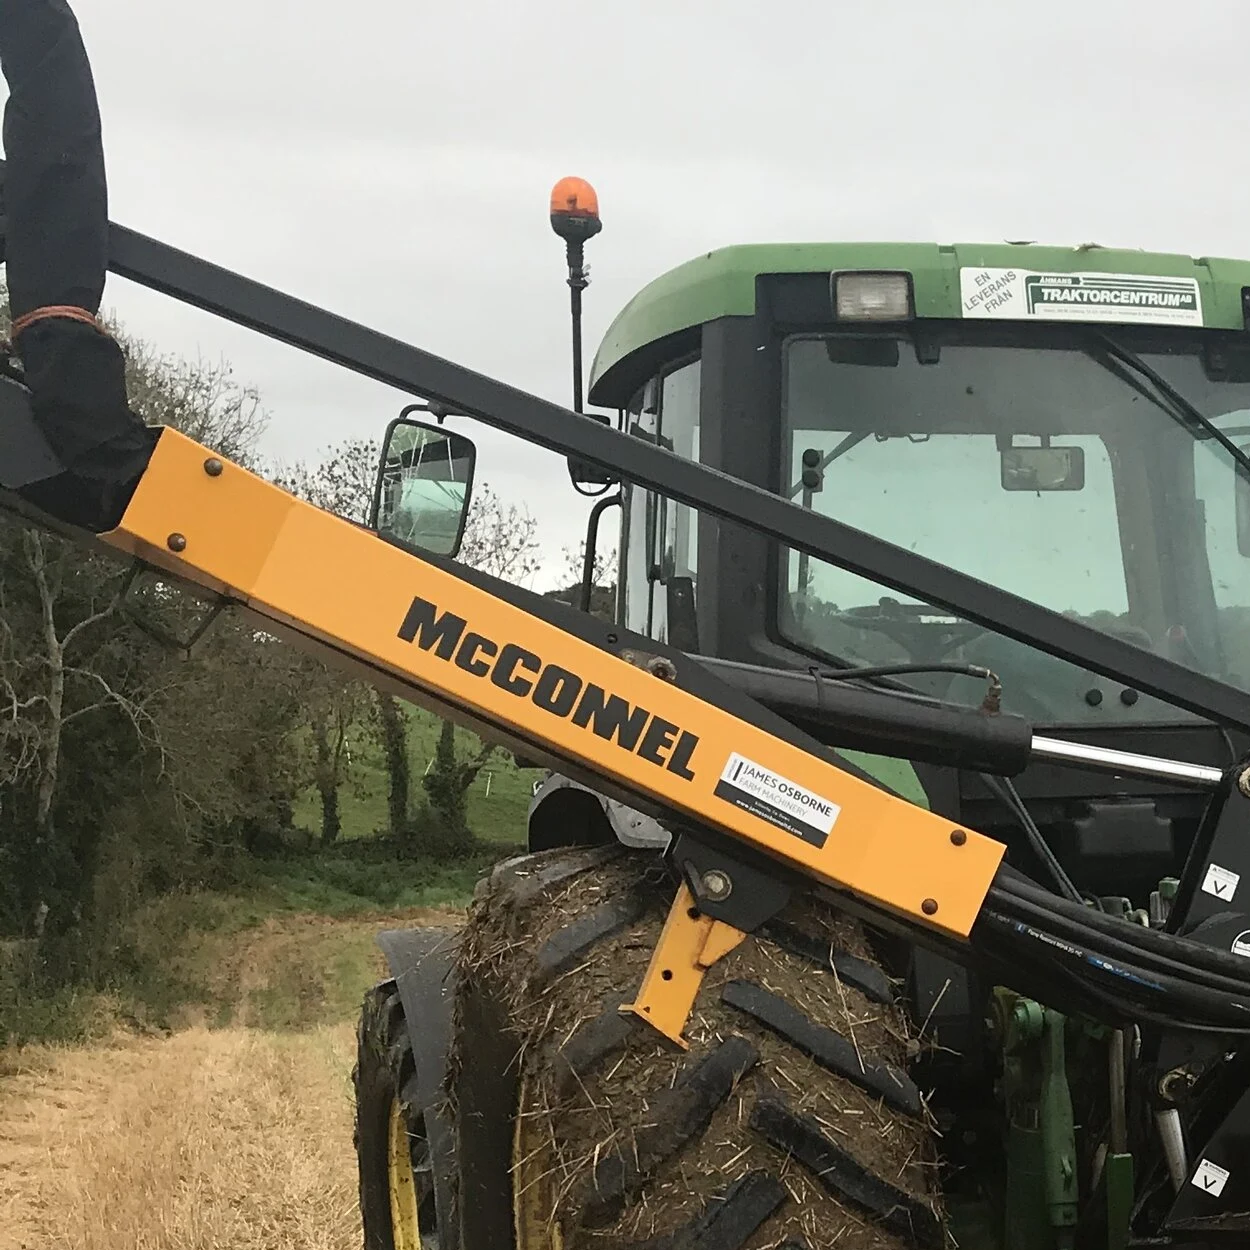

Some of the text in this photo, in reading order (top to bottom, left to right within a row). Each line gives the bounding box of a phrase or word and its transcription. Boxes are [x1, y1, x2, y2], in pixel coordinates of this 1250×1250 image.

[964, 270, 1017, 312] LEVERANS
[974, 271, 992, 287] EN
[1041, 288, 1180, 307] TRAKTORCENTRUM
[739, 776, 762, 793] FARM
[762, 788, 809, 817] MACHINERY
[743, 764, 778, 789] JAMES
[778, 783, 833, 817] OSBORNE
